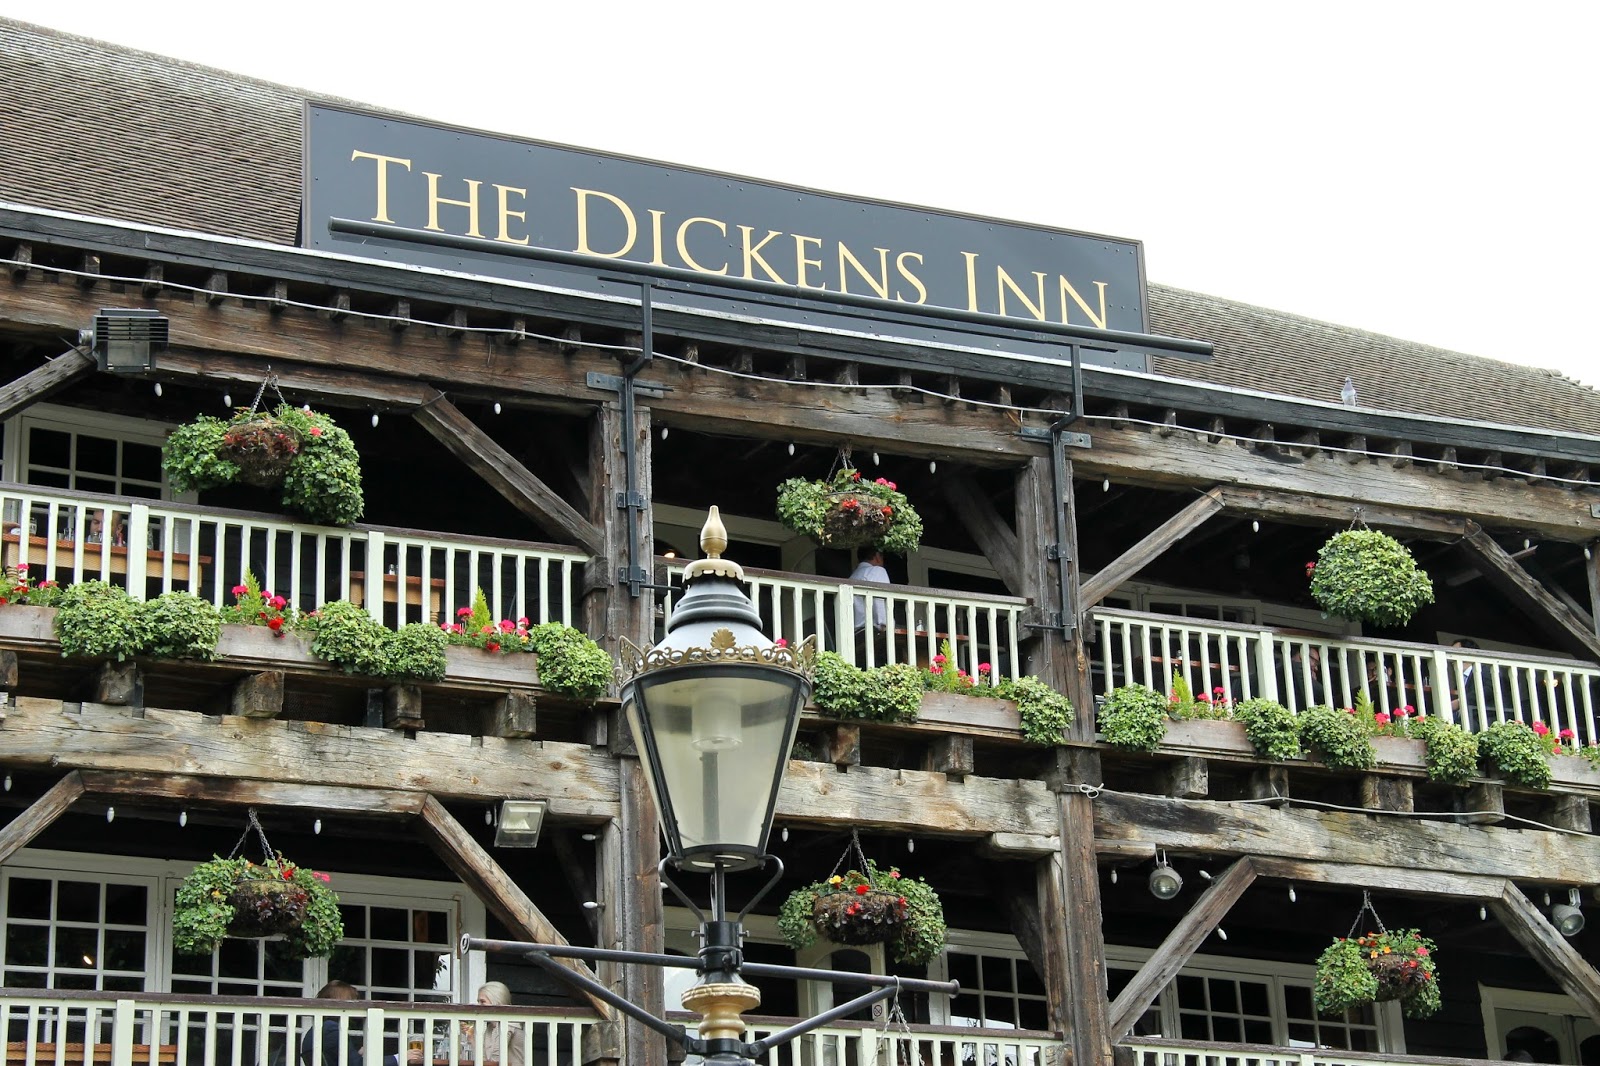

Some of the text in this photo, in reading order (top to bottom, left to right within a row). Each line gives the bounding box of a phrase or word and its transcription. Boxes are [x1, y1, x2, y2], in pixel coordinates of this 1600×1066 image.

[351, 149, 1109, 331] THE DICKENS INN
